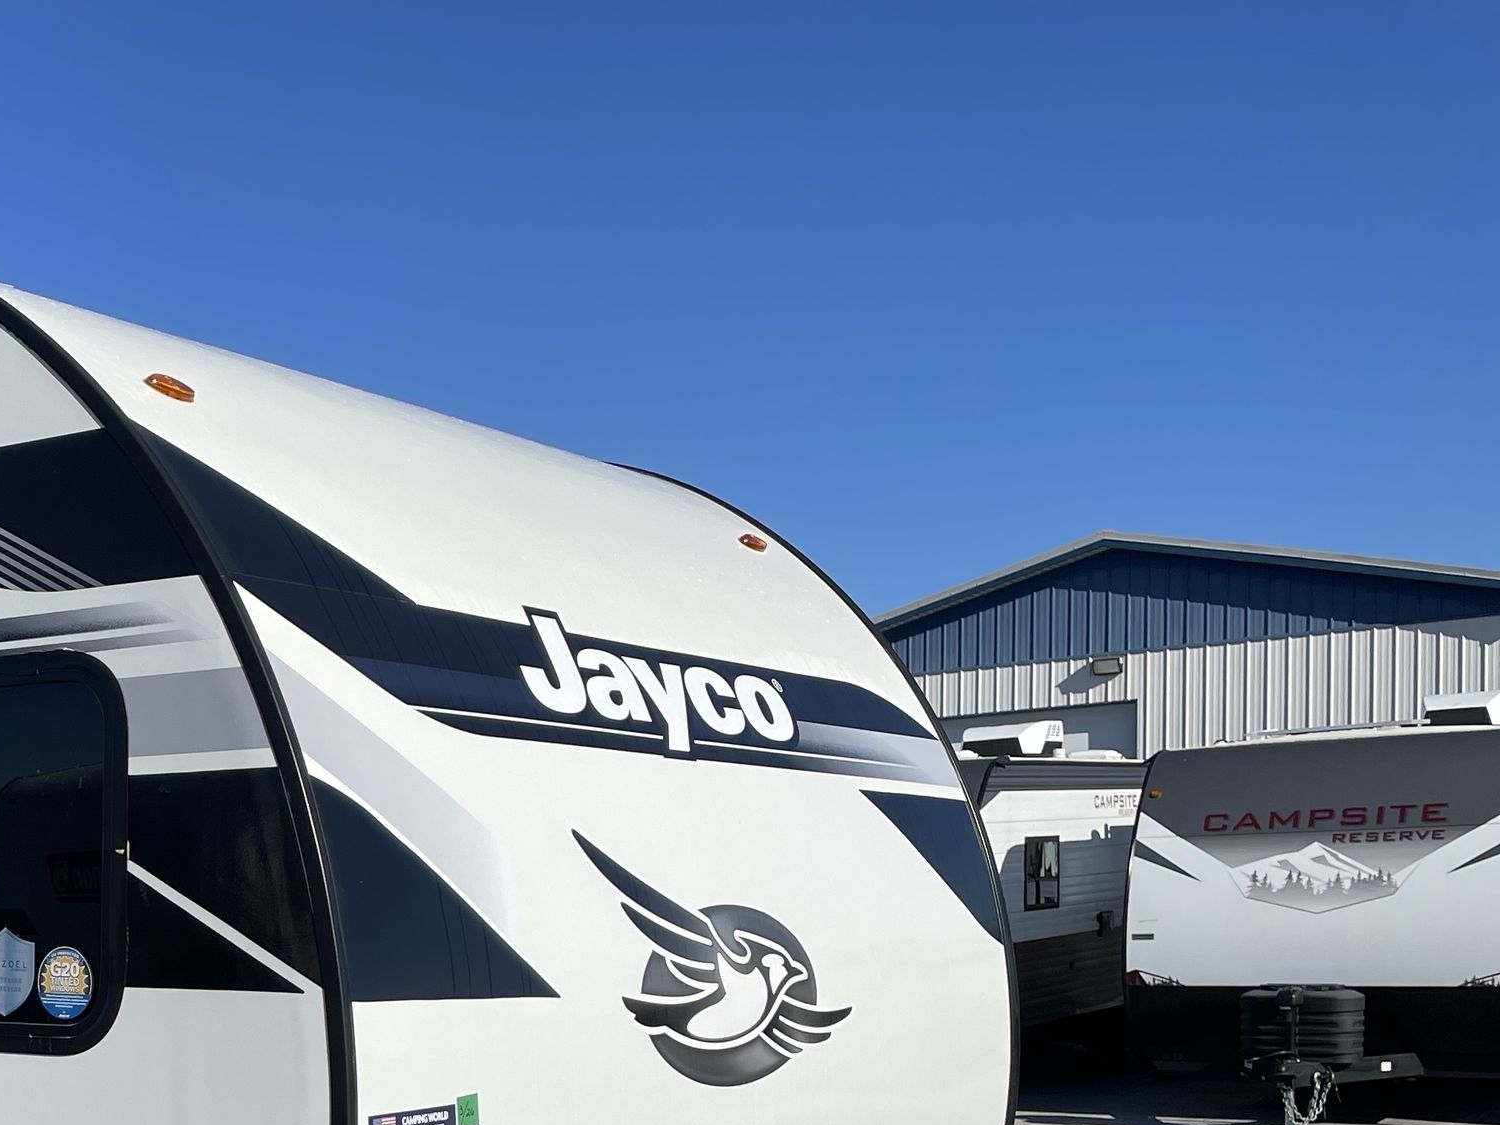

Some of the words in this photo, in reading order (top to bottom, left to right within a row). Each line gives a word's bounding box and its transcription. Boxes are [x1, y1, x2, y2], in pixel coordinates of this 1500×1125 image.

[519, 614, 795, 752] Jayco
[1094, 794, 1138, 808] CAMPSITE
[1203, 802, 1449, 832] CAMPSITE
[1331, 829, 1447, 844] RESERVE
[49, 961, 80, 978] G20
[428, 1110, 449, 1123] WORLD
